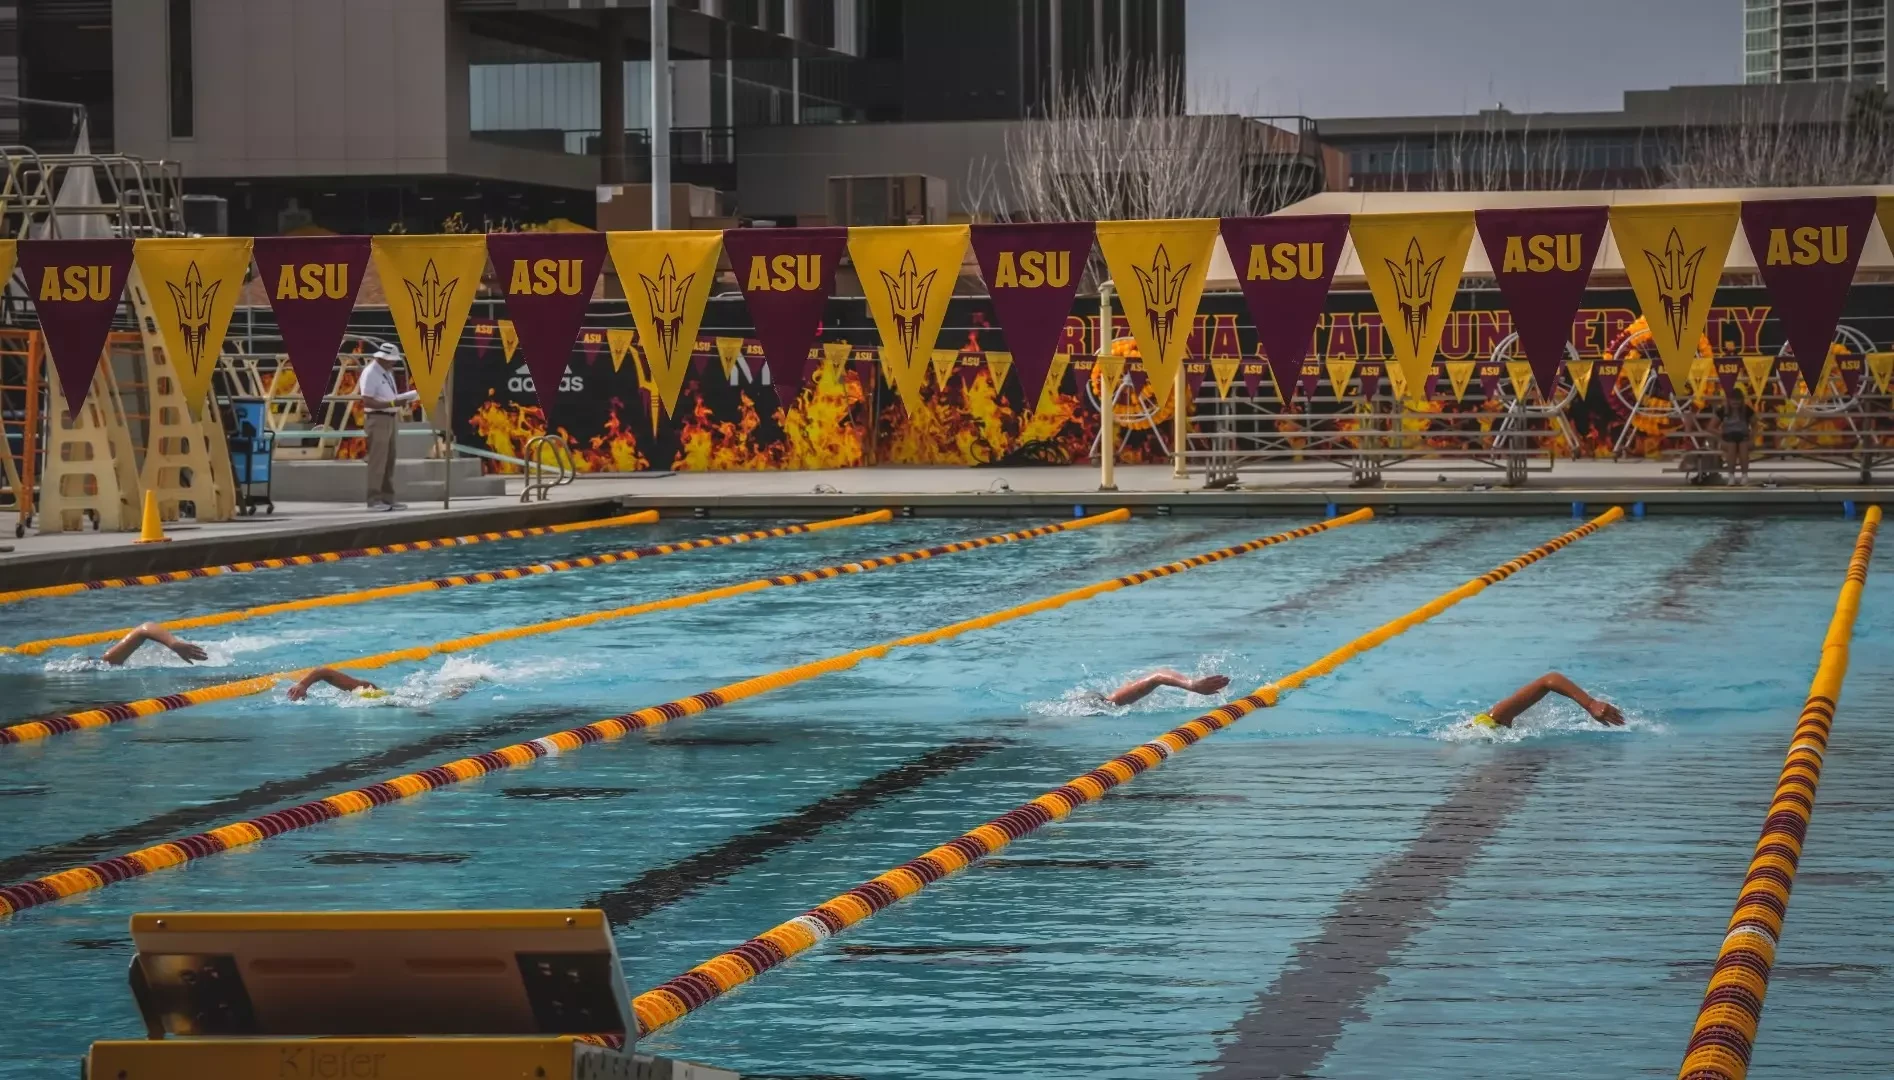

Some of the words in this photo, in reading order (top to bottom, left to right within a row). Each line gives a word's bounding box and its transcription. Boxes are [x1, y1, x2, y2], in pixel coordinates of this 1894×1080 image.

[1247, 242, 1324, 281] ASU
[1502, 234, 1582, 273] ASU
[1767, 226, 1848, 266] ASU
[40, 265, 111, 302] ASU
[276, 263, 348, 300] ASU
[509, 259, 583, 296] ASU
[747, 254, 822, 292] ASU
[994, 250, 1071, 288] ASU
[961, 356, 980, 367] ASU
[1243, 364, 1263, 374] ASU
[1360, 366, 1380, 376] ASU
[1480, 366, 1500, 376] ASU
[1598, 366, 1618, 375] ASU
[279, 1046, 387, 1079] Kiefer
